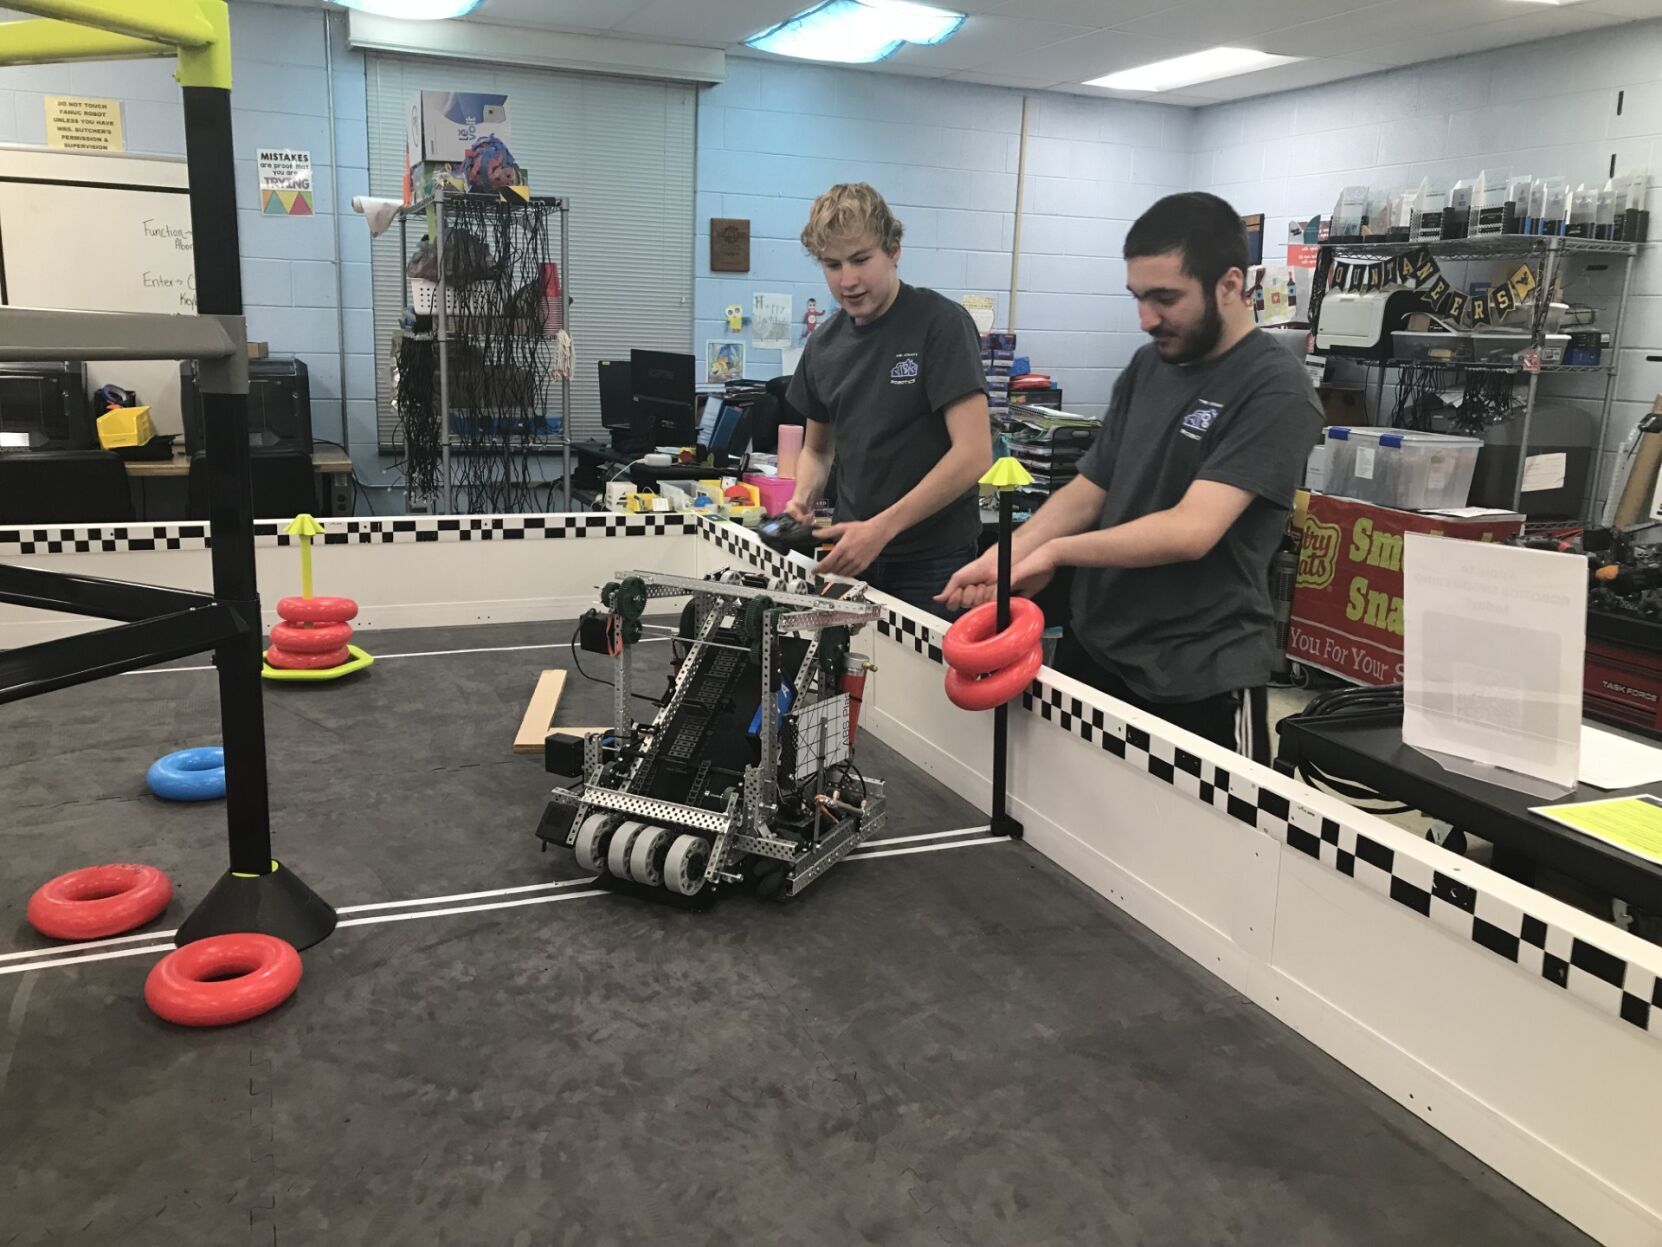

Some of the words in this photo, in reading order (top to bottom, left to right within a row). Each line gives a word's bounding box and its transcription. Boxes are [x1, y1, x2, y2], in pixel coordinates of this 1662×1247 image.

[61, 134, 102, 142] PERMISSION
[260, 152, 309, 162] MISTAKES
[264, 176, 310, 190] TRYING
[142, 218, 183, 240] Function
[142, 270, 173, 288] Enter
[1349, 517, 1404, 572] Sm
[1290, 627, 1321, 654] You
[1324, 638, 1349, 665] For
[1351, 647, 1390, 681] Your
[1602, 680, 1626, 693] TASK
[1626, 687, 1657, 702] FORCE
